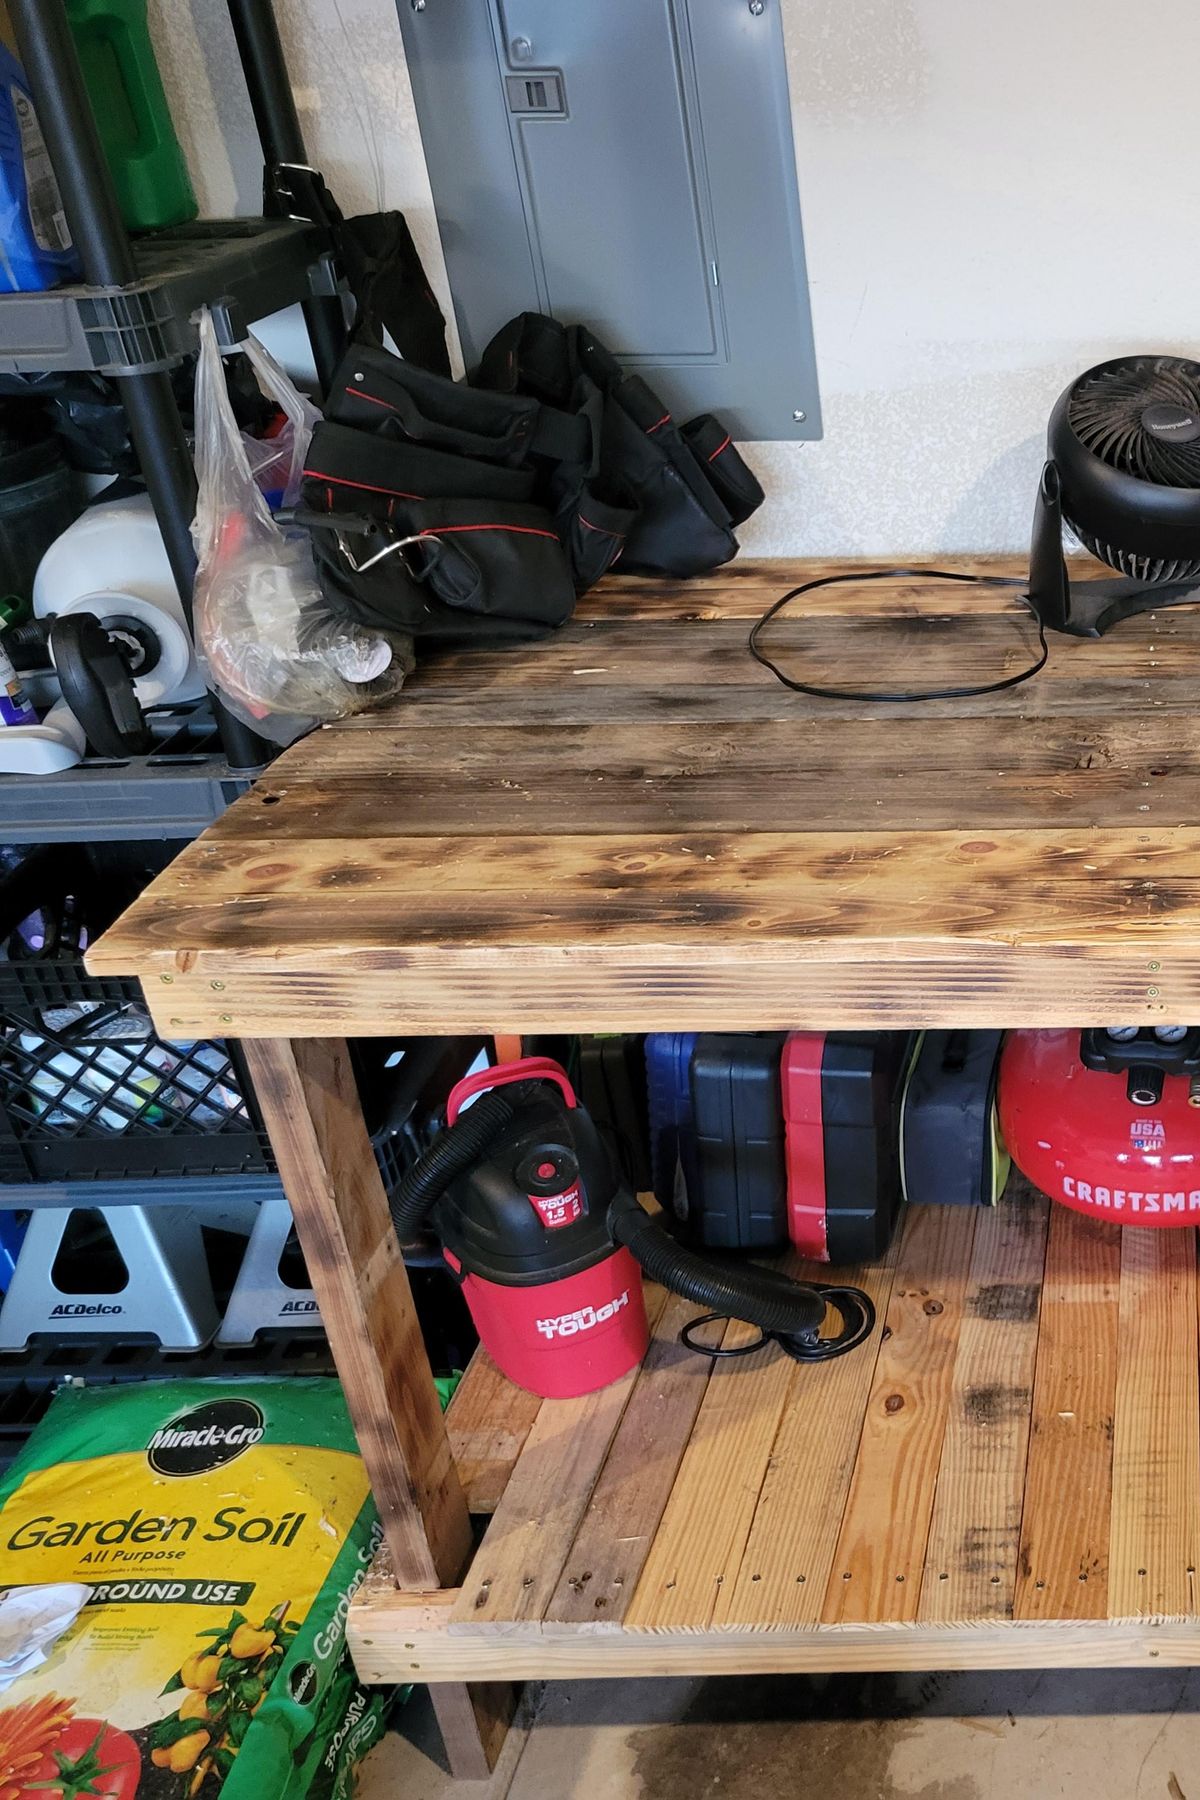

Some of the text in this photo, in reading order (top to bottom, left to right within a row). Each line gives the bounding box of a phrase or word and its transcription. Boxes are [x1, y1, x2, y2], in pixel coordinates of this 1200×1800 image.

[1131, 1123, 1165, 1137] USA
[547, 1207, 565, 1219] 1.5
[51, 1303, 122, 1315] ACDelco
[536, 1306, 594, 1328] HYPER
[538, 1291, 629, 1339] TOUGH
[7, 1507, 307, 1550] Garden Soil
[79, 1549, 186, 1564] All Purpose
[89, 1584, 241, 1601] ROUND USE
[325, 1691, 366, 1772] PURPOSE
